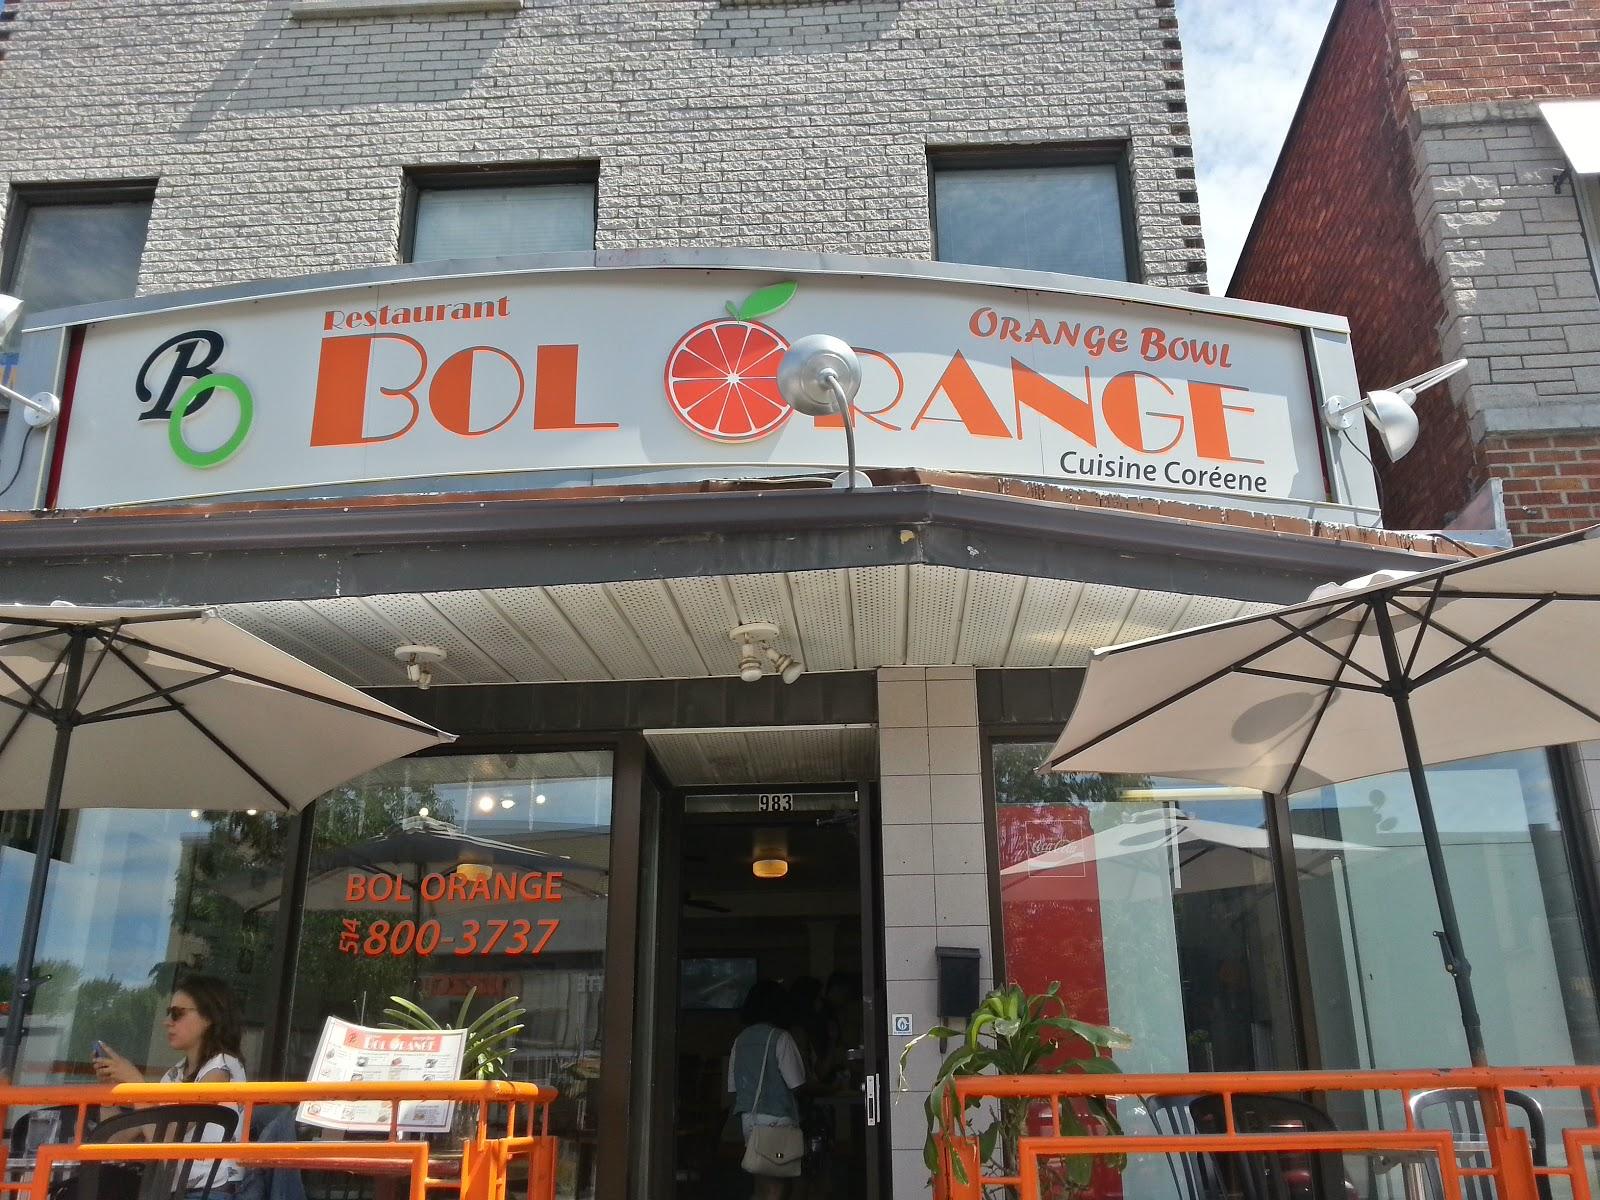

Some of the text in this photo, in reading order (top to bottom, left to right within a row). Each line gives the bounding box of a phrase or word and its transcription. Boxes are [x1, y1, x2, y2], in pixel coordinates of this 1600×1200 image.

[323, 295, 511, 331] Restaurant
[968, 306, 1233, 368] ORANGE BOWL
[309, 332, 620, 447] BOL
[1060, 450, 1268, 494] Cuisine Coréene
[760, 795, 792, 811] 983
[346, 871, 563, 902] BOL ORANGE
[339, 918, 560, 957] 514 800-3737
